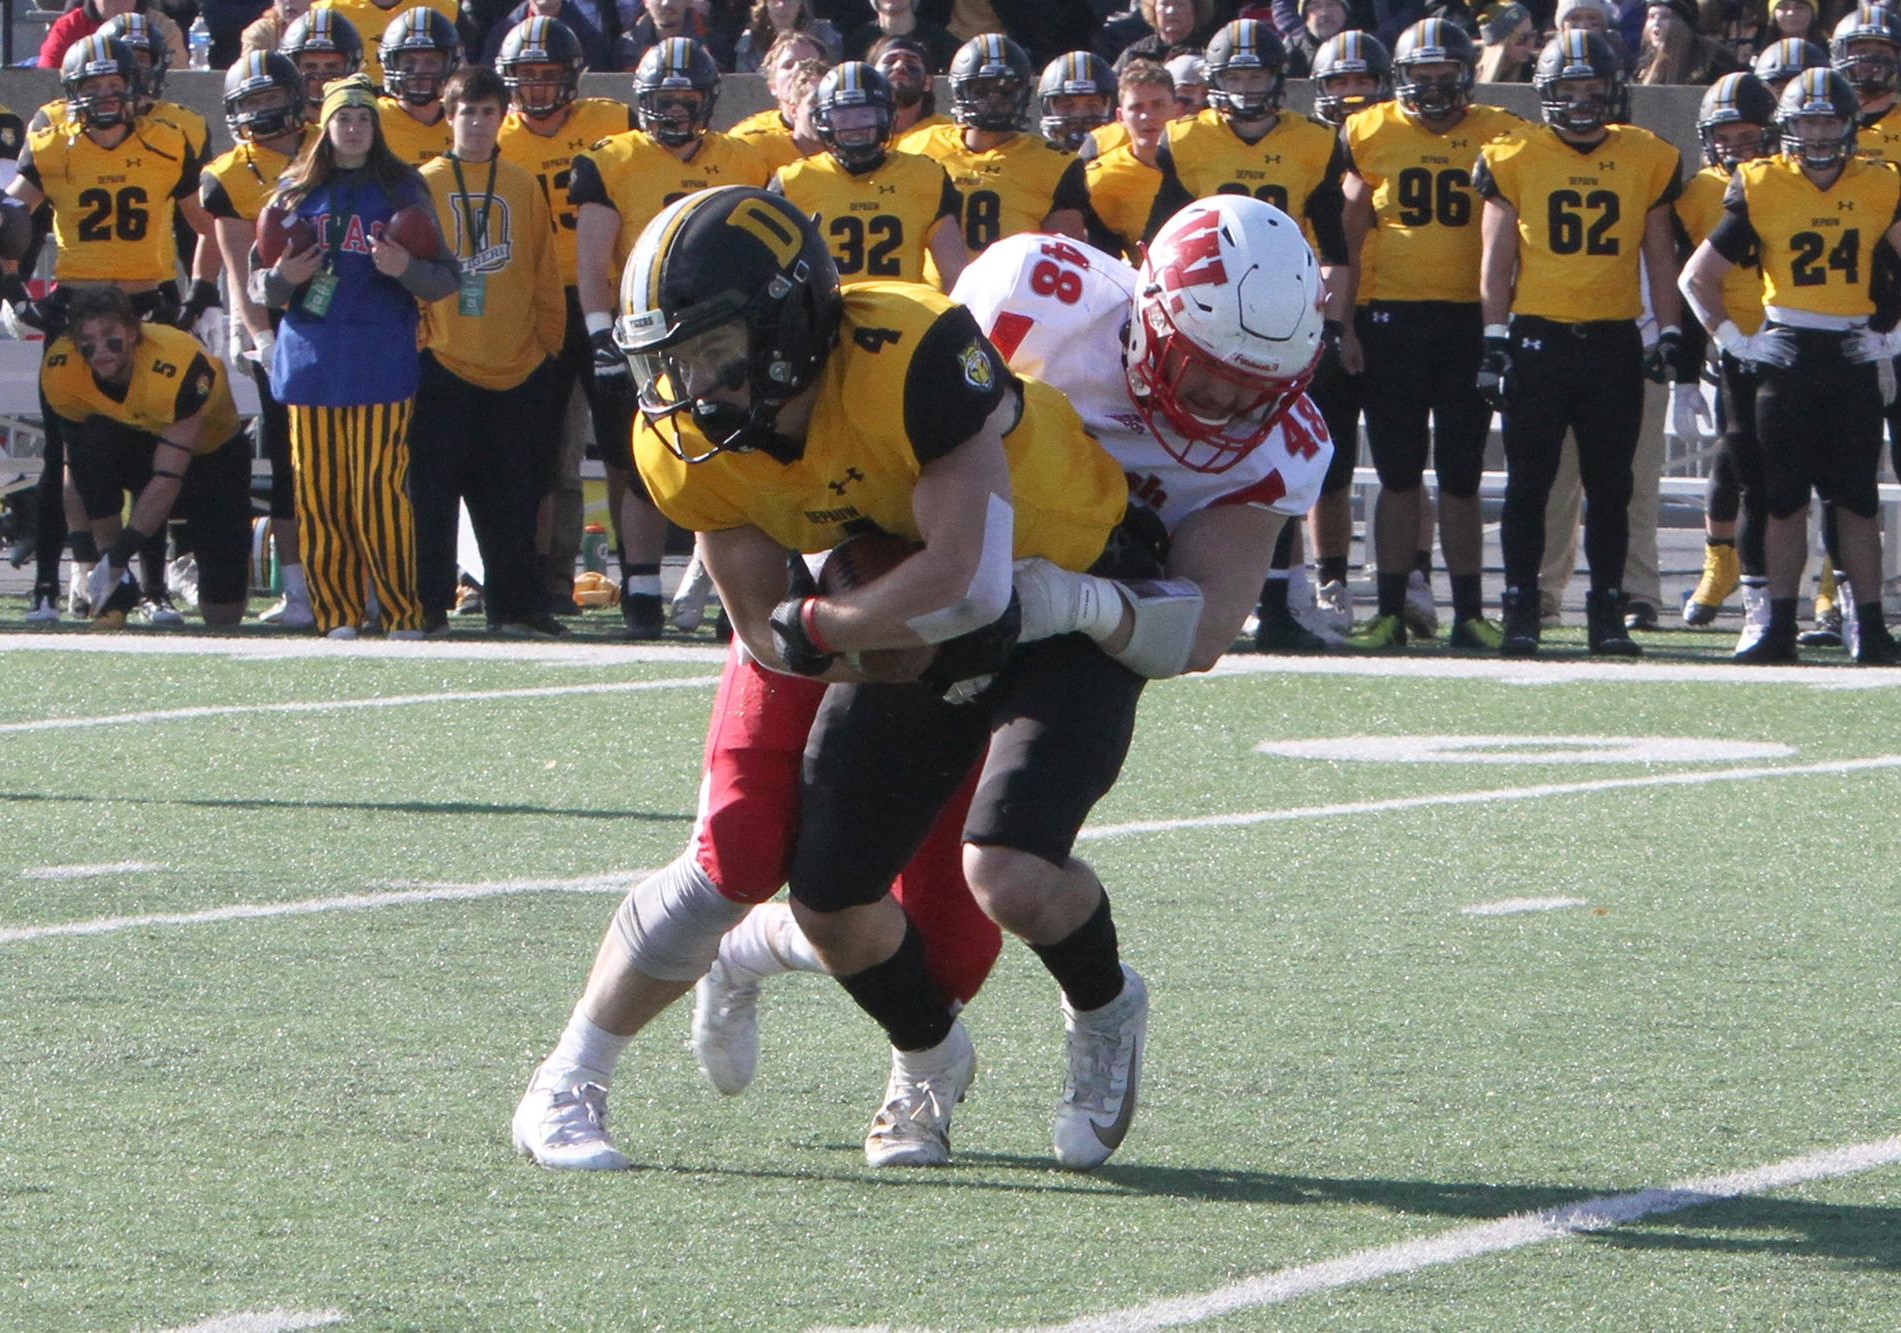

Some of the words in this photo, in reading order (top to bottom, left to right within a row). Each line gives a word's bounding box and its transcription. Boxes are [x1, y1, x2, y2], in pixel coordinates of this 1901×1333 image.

[78, 186, 149, 242] 26
[1399, 167, 1471, 227] 96
[1548, 189, 1620, 255] 62
[725, 198, 803, 269] D
[830, 214, 904, 276] 32
[1163, 209, 1228, 292] W
[1790, 229, 1859, 287] 24
[1030, 241, 1090, 306] 48
[48, 354, 68, 367] 5
[152, 360, 177, 378] 5
[853, 326, 903, 354] 4
[1281, 396, 1331, 462] 48
